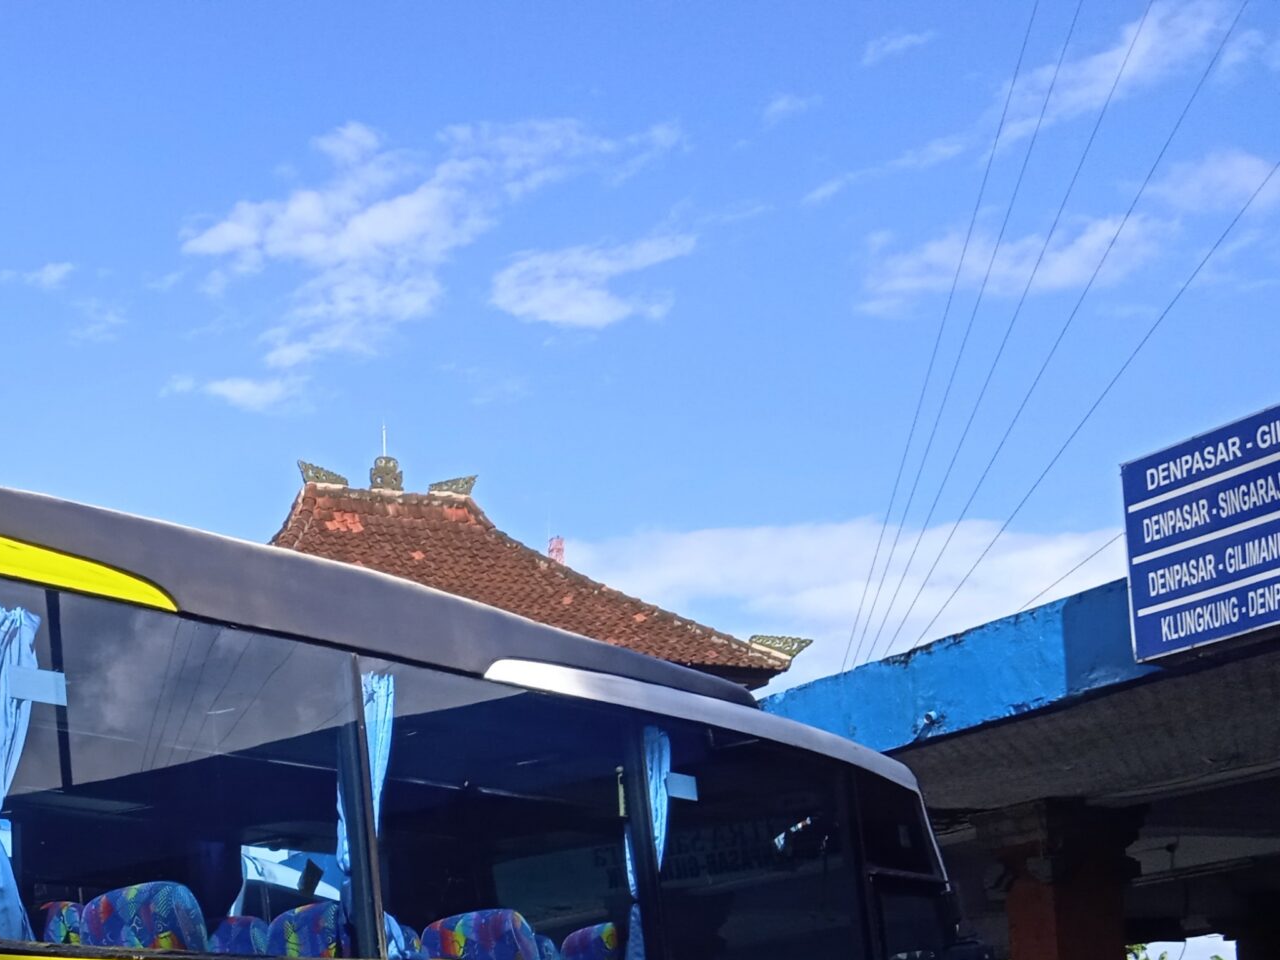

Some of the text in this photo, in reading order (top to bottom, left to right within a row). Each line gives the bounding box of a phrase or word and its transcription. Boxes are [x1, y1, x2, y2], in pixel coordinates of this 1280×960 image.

[1146, 436, 1242, 491] DENPASAR
[1142, 499, 1210, 543] DENPASAR
[1148, 554, 1217, 597] DENPASAR
[1160, 596, 1239, 642] KLUNGKUNG
